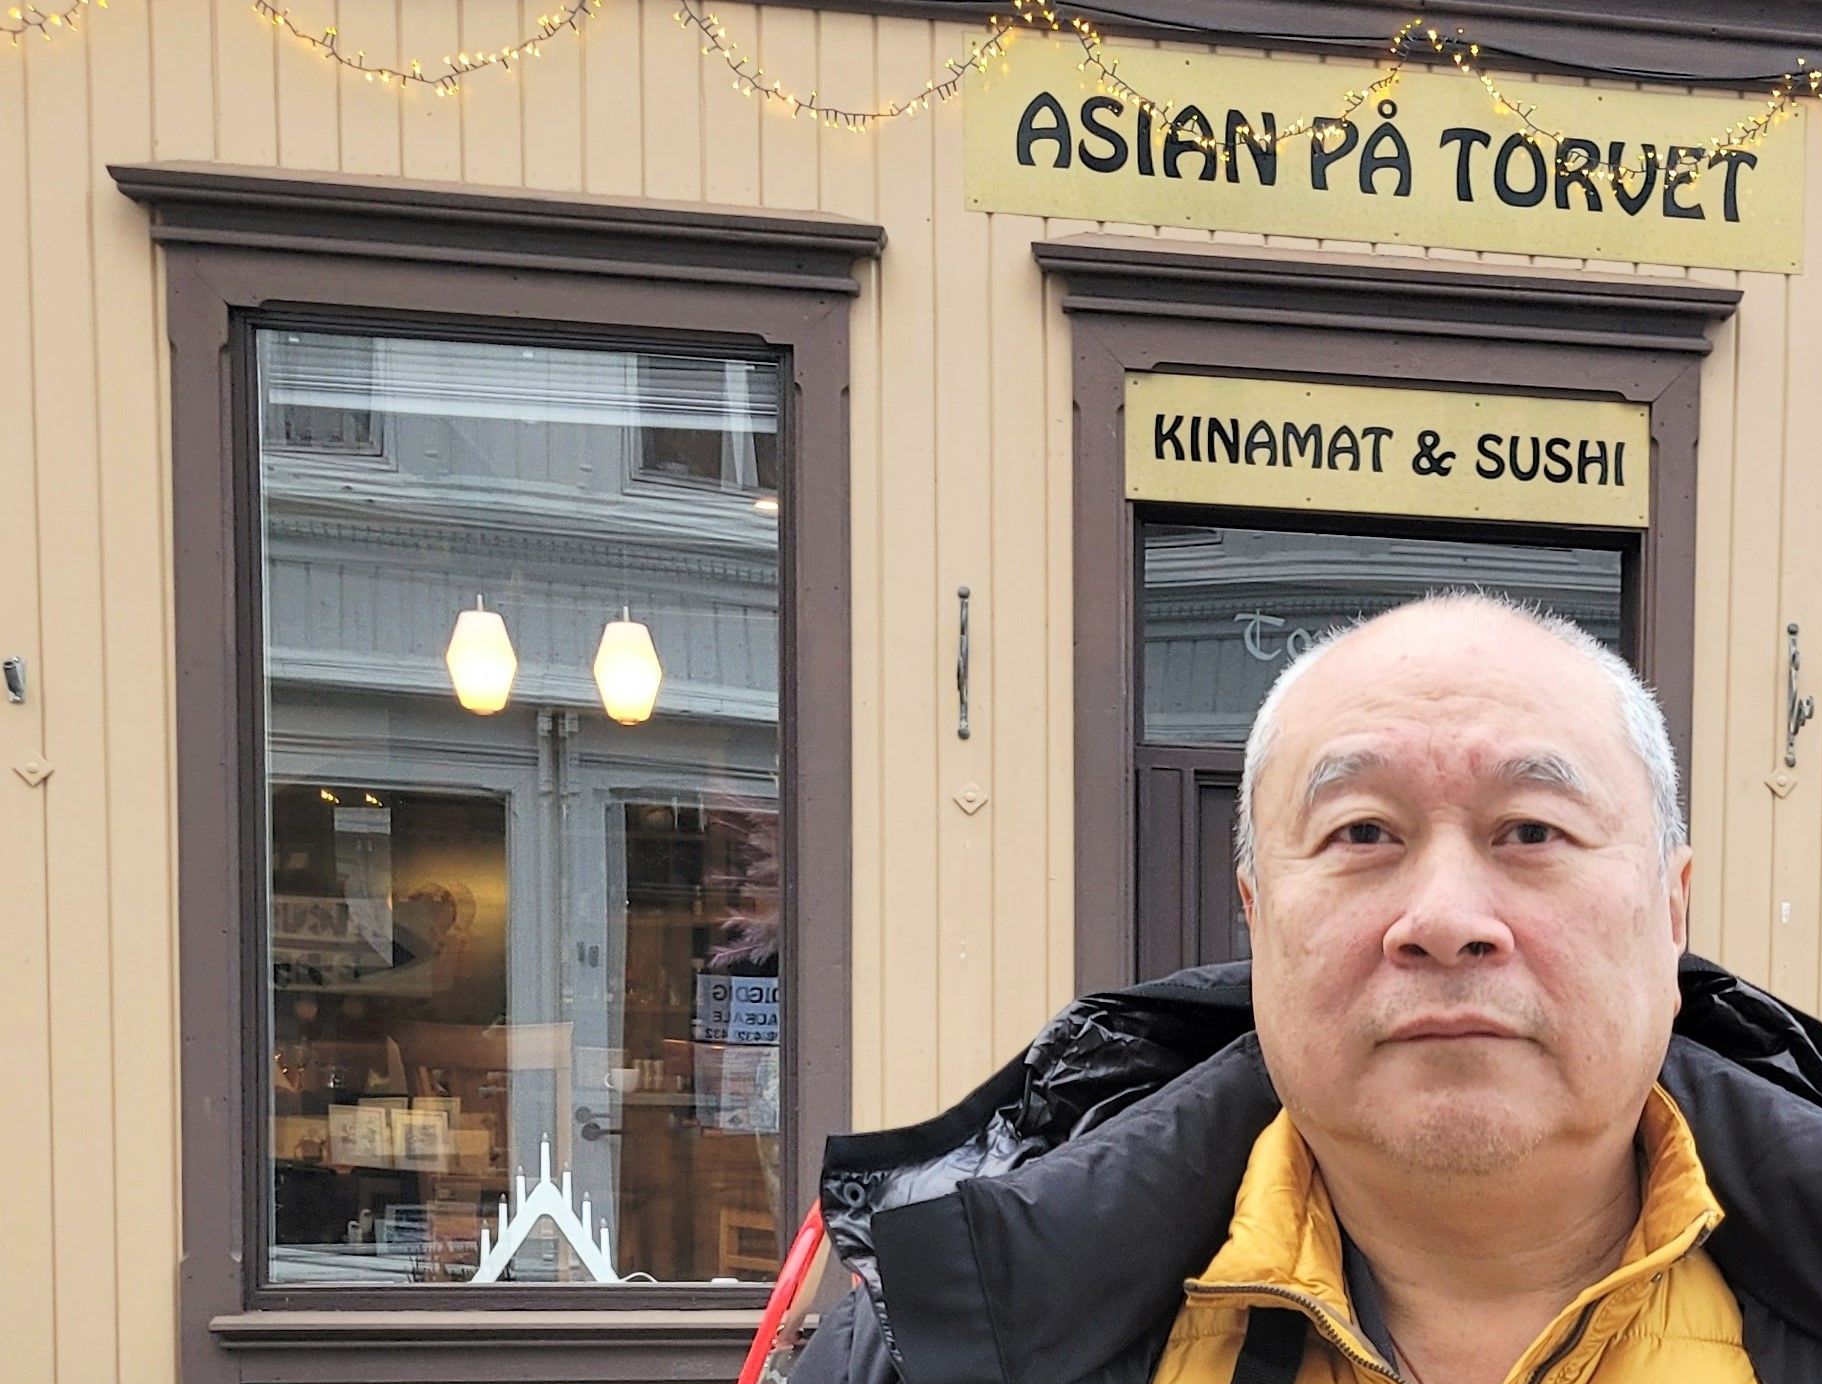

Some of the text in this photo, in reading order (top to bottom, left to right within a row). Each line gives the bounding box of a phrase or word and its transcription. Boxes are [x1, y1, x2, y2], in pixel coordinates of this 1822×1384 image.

[1016, 90, 1758, 223] ASIAN PÅ TORVET
[1154, 413, 1626, 487] KINAMAT & SUSHI
[1233, 608, 1320, 661] To
